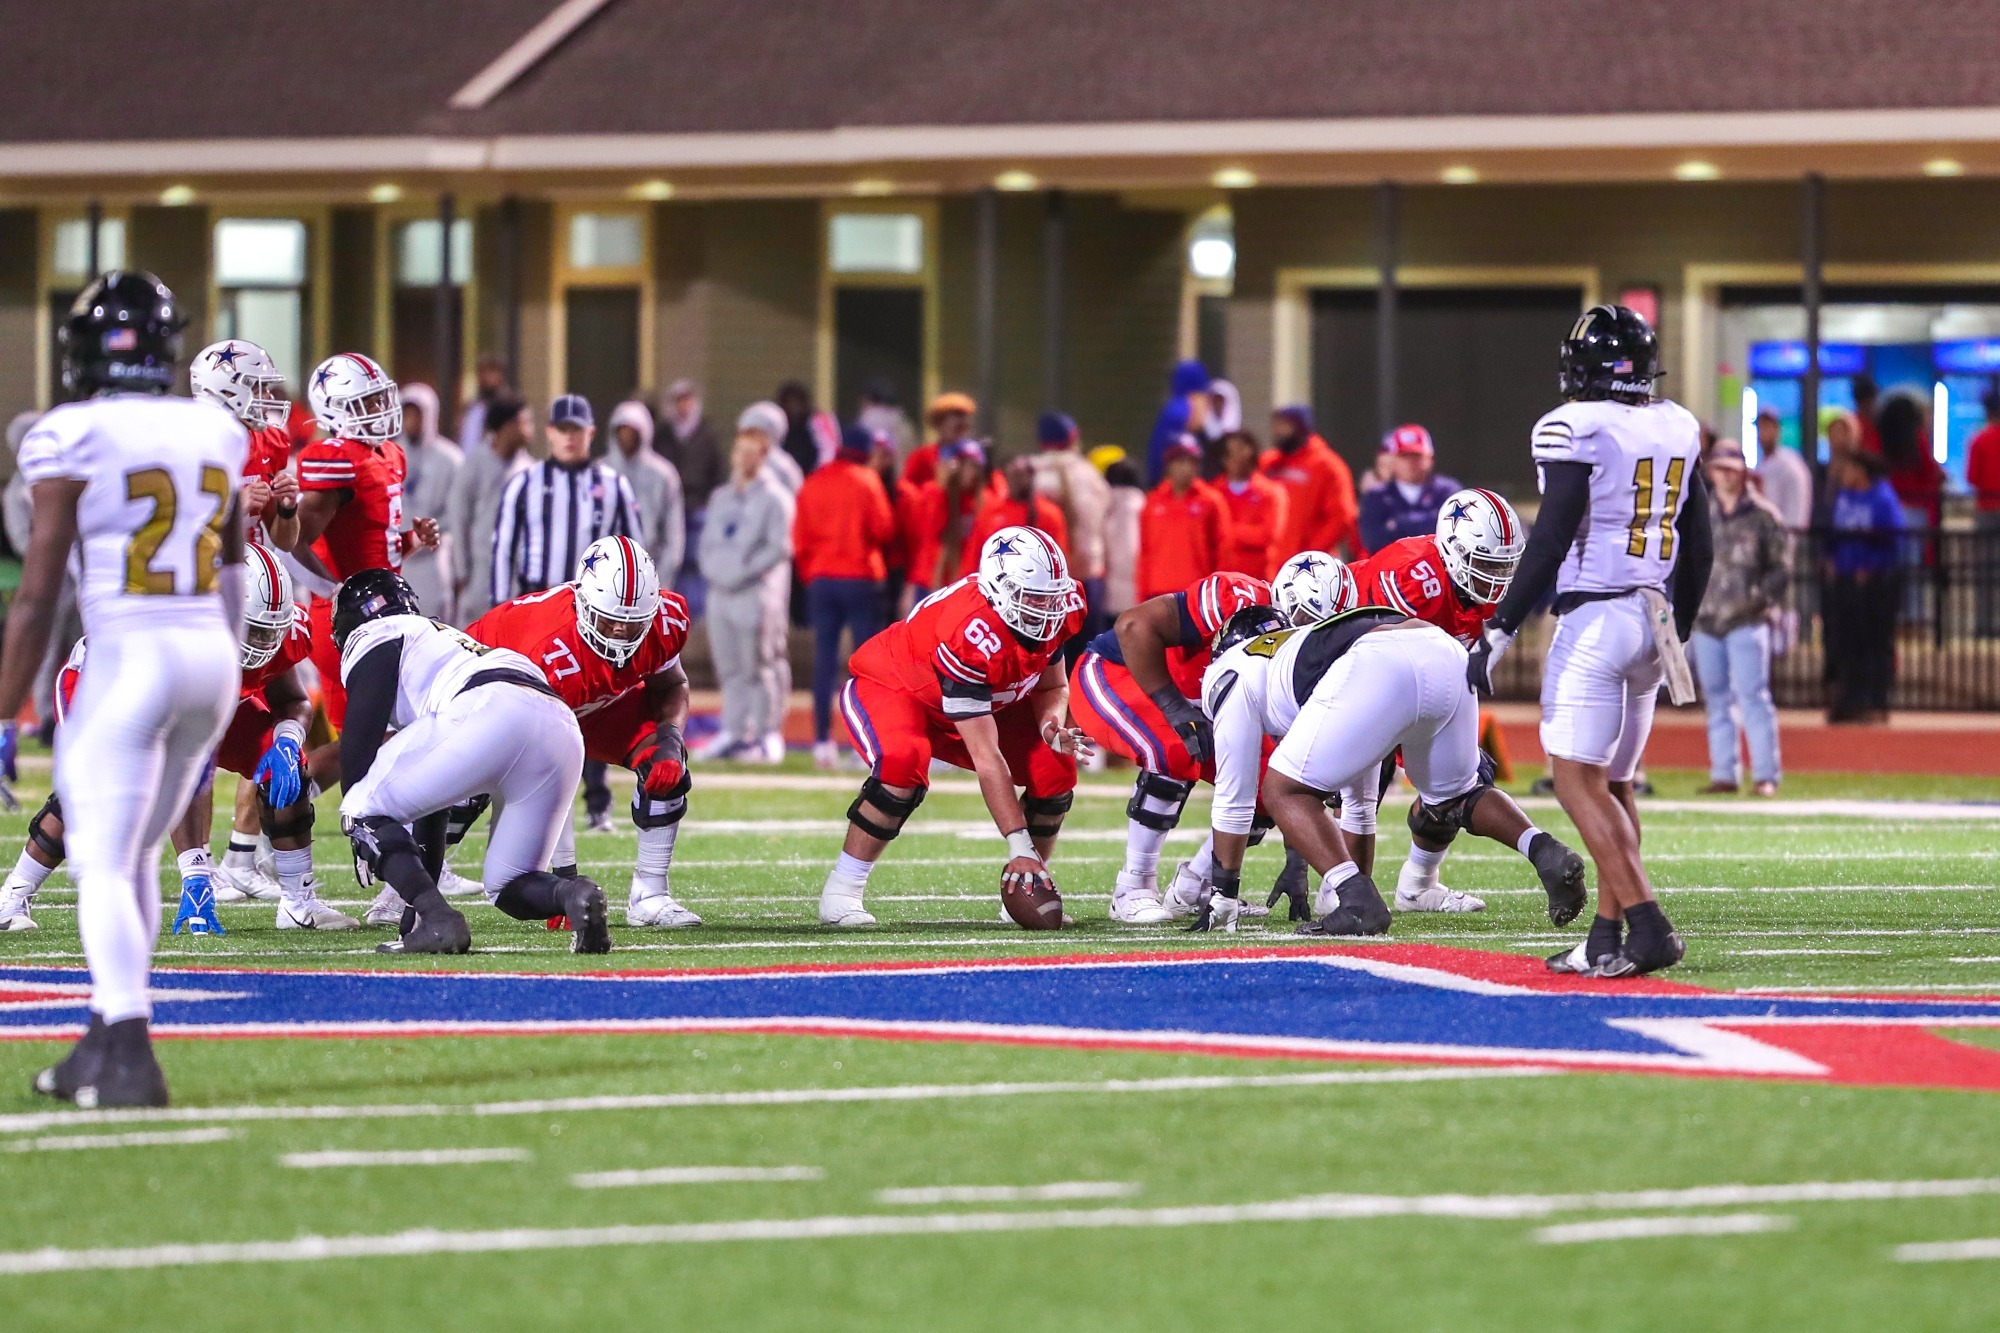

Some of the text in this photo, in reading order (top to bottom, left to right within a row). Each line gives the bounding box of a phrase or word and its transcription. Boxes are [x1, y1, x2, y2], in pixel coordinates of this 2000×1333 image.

[1626, 457, 1685, 561] 11
[1410, 560, 1442, 600] 58
[659, 597, 687, 637] 77
[543, 637, 581, 681] 77
[964, 618, 1002, 661] 62
